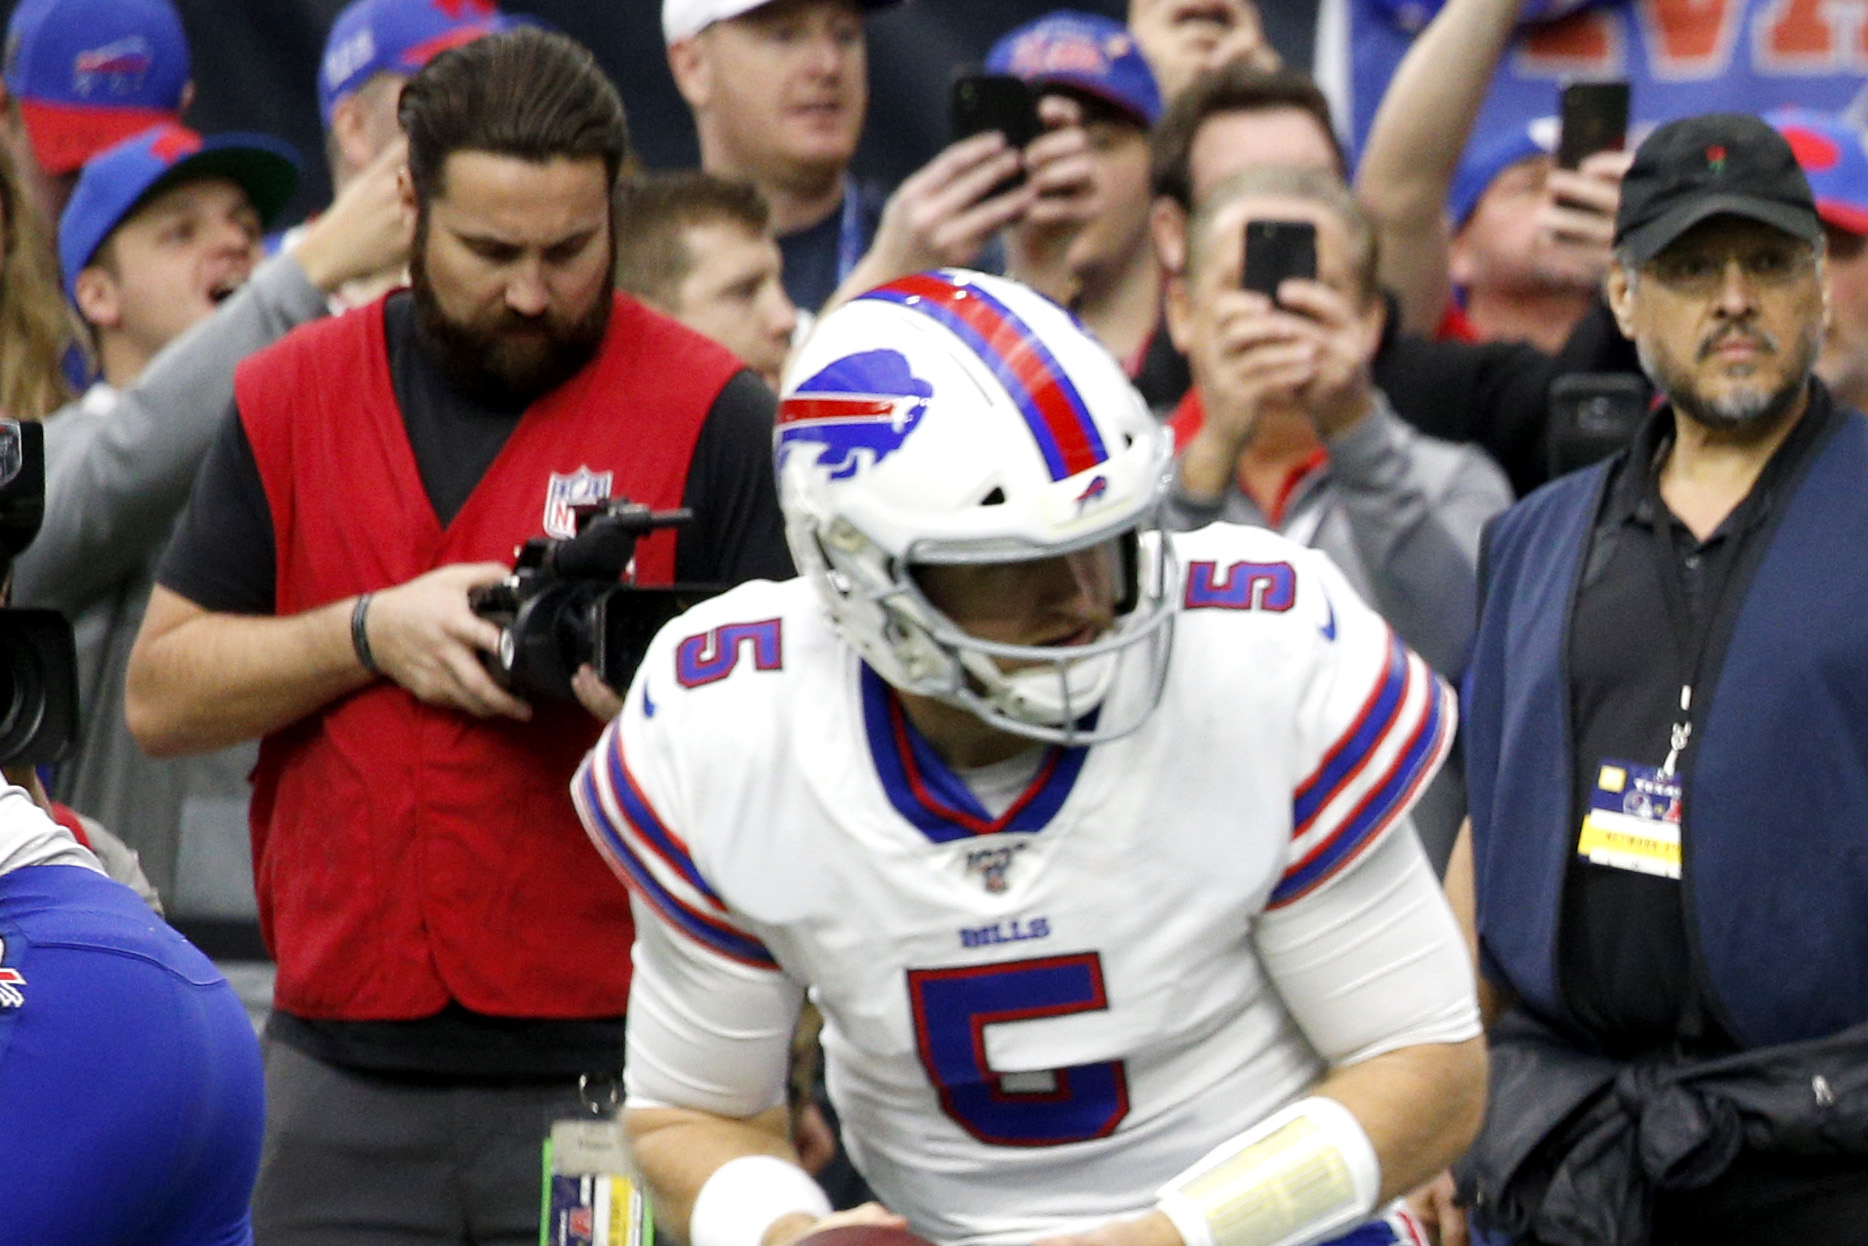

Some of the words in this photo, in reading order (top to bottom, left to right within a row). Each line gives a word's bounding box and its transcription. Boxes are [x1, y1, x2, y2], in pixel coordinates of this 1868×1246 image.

[1183, 560, 1296, 612] 5
[676, 617, 782, 689] 5
[959, 918, 1050, 948] BILLS
[907, 951, 1130, 1148] 5
